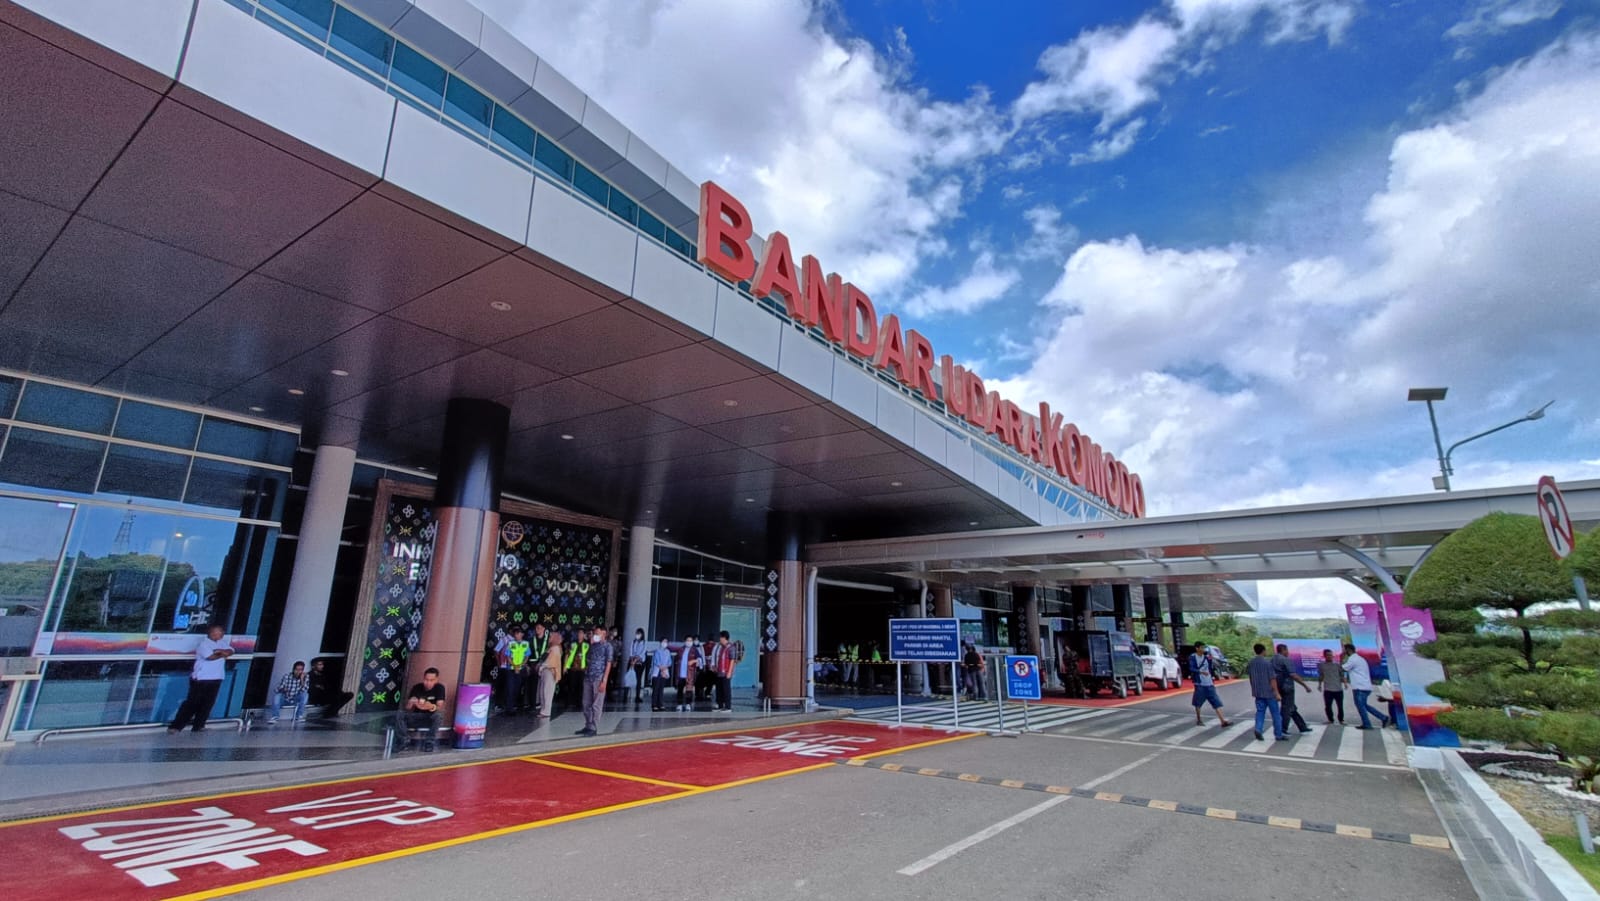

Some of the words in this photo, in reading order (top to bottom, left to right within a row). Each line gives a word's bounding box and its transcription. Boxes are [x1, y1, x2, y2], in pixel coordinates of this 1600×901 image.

[698, 180, 936, 400] BANDAR
[941, 354, 1041, 463] UDARA
[1039, 402, 1146, 518] KOMODO
[700, 735, 860, 757] ZONE
[266, 789, 455, 830] VIP
[58, 806, 329, 888] ZONE
